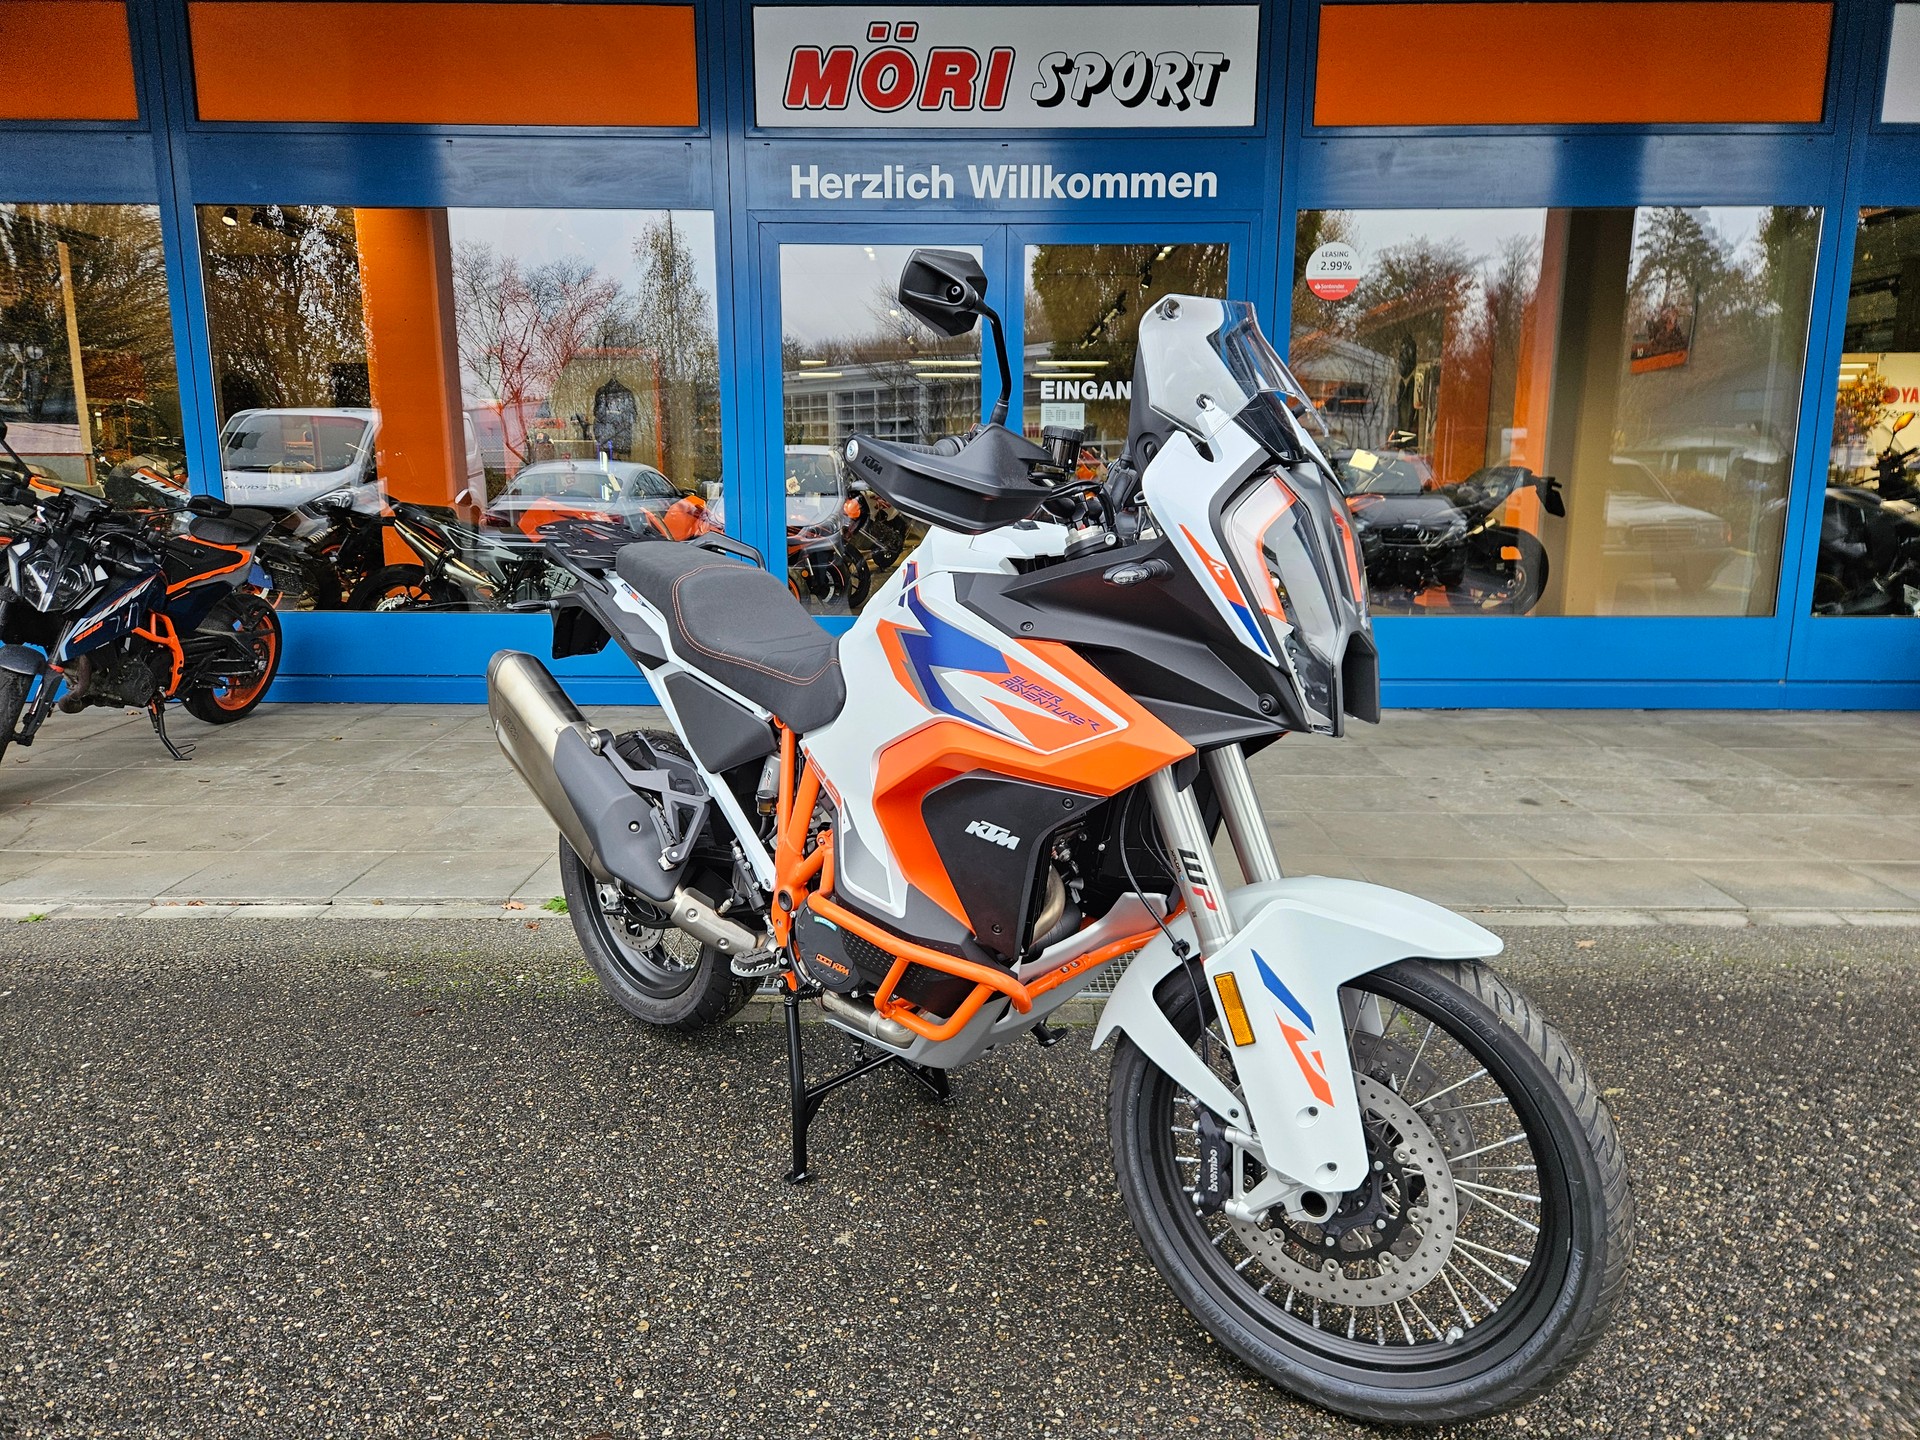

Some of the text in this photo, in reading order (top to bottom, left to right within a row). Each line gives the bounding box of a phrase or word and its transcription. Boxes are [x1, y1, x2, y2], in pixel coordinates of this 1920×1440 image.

[782, 21, 1231, 113] MÖRI SPORT
[791, 164, 1218, 199] Herzlich Willkommen
[1320, 260, 1352, 271] 2.99%
[1321, 250, 1349, 258] LEASING
[1040, 380, 1132, 400] EINGAN
[861, 455, 883, 476] KTM
[130, 470, 192, 503] DUK
[999, 679, 1086, 726] ADVENTURE
[1008, 675, 1064, 704] SUPER
[964, 820, 1021, 851] KTM
[1207, 1149, 1218, 1192] brembo
